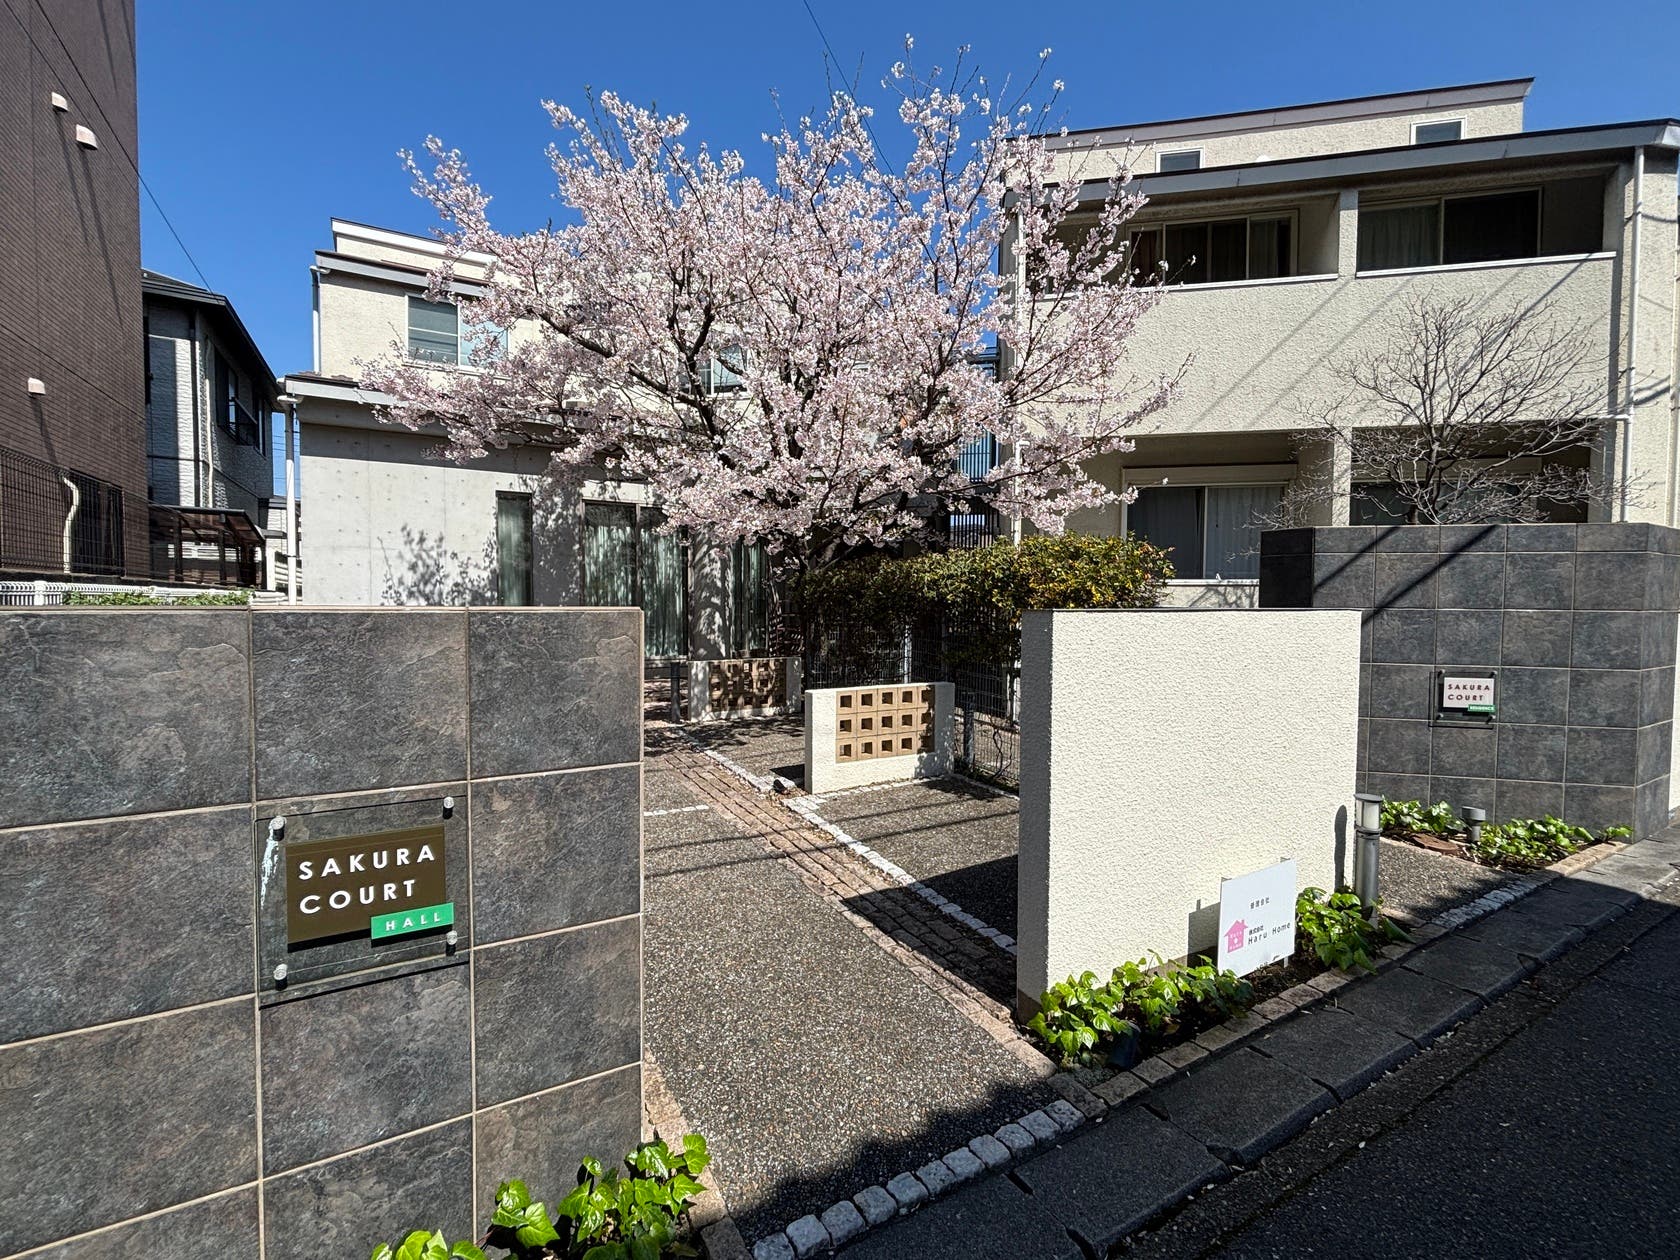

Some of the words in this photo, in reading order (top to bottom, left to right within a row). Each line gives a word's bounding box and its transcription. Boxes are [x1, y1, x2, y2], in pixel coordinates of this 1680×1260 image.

[298, 844, 435, 880] SAKURA
[299, 879, 416, 914] COURT
[385, 912, 441, 931] HALL
[1248, 933, 1267, 945] Haru
[1272, 922, 1290, 934] Home
